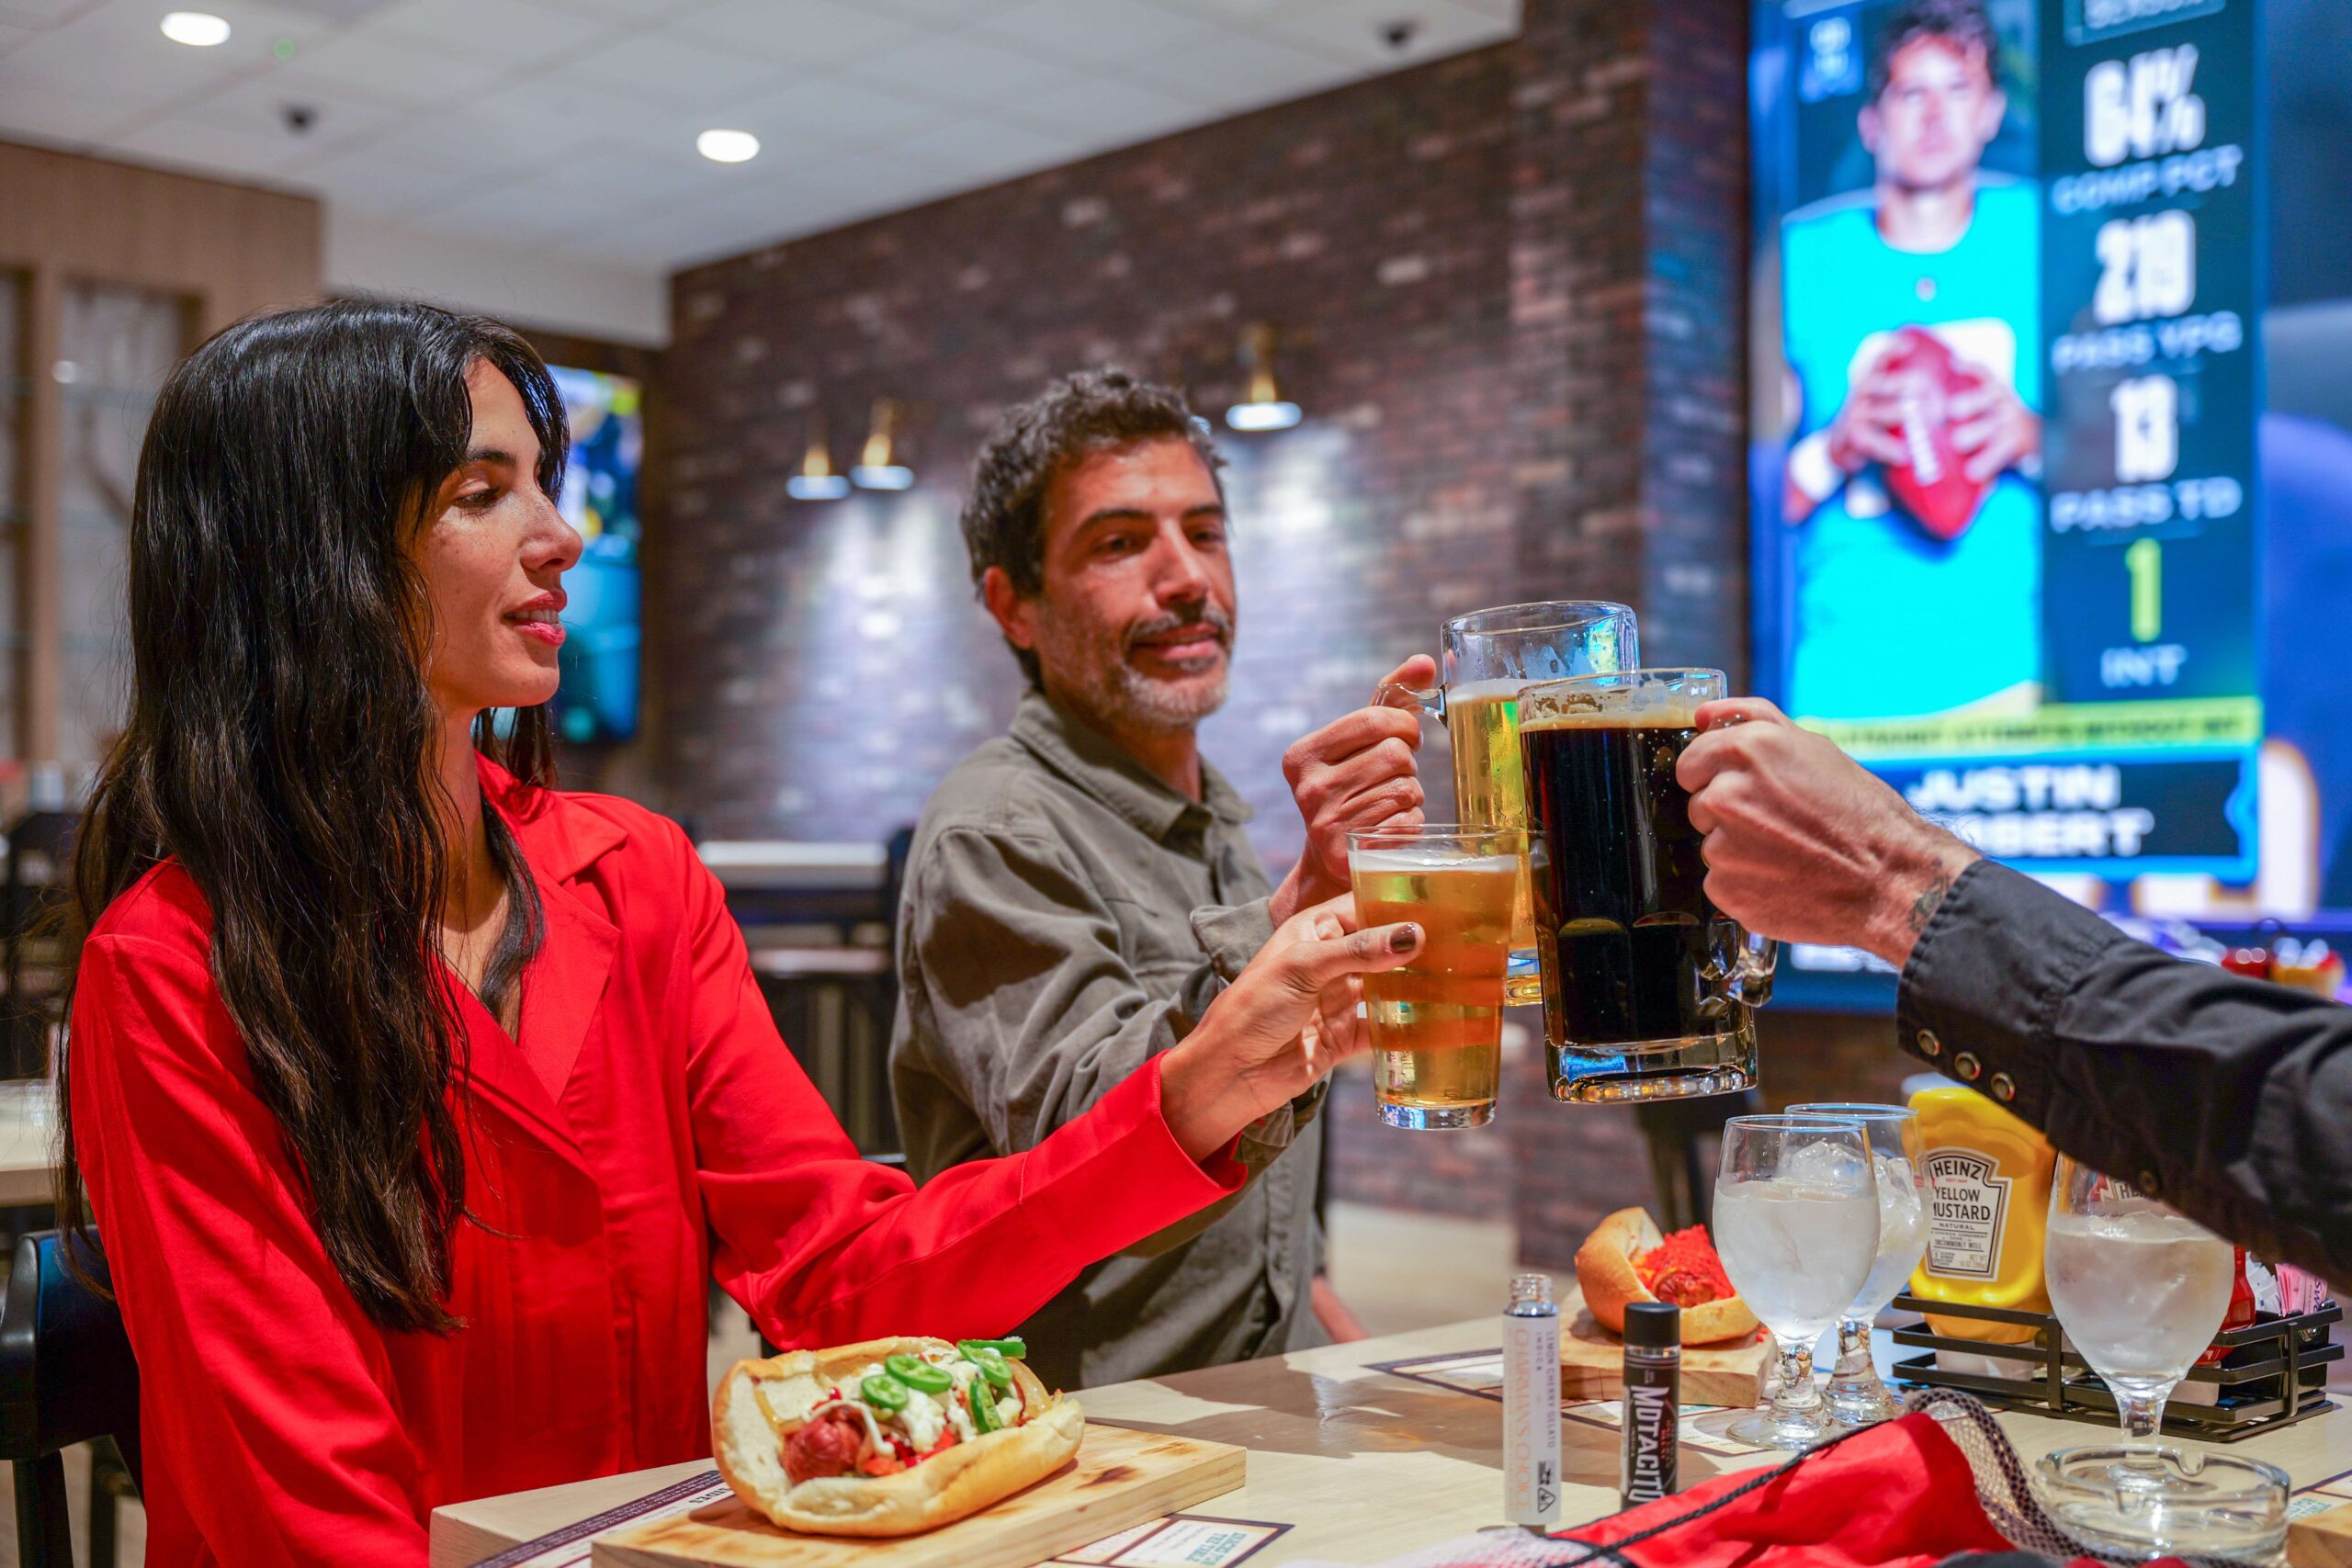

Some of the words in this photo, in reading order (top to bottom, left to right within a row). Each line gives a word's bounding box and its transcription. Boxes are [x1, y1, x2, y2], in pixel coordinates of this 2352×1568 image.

[2161, 144, 2243, 197] PCT
[2052, 323, 2155, 377] PASS
[2050, 483, 2174, 533] PASS
[2174, 476, 2243, 520] TD
[2125, 537, 2162, 642] 1
[2100, 644, 2188, 688] INT
[1905, 764, 2121, 813] JUSTIN
[1957, 807, 2154, 857] BERT
[1933, 1160, 1982, 1180] HEINZ
[1934, 1186, 1981, 1202] YELLOW
[1939, 1223, 1974, 1231] NATURAL
[1545, 1331, 1555, 1364] LEMON
[1546, 1368, 1555, 1407] CHERRY
[1547, 1410, 1555, 1448] GELATO
[1628, 1384, 1670, 1503] MOTACITO
